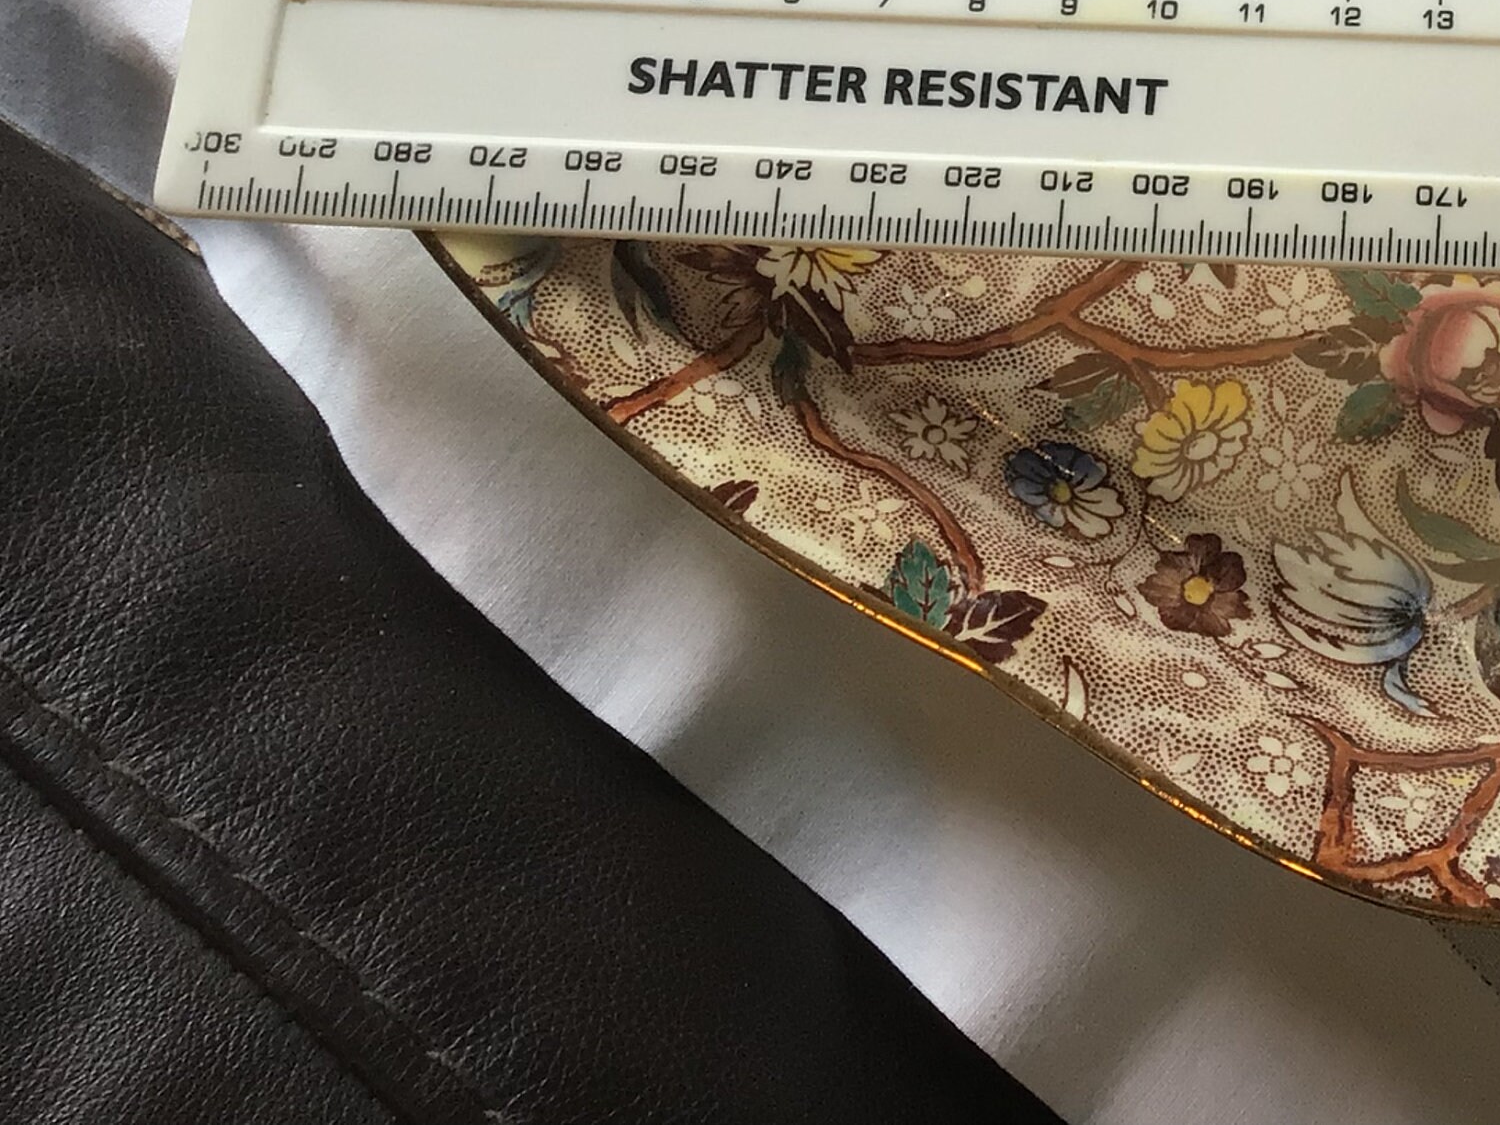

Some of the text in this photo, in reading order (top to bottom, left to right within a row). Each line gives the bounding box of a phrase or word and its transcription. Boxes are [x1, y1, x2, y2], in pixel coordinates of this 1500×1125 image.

[1147, 0, 1178, 19] 10
[1240, 4, 1264, 22] 11
[1331, 7, 1361, 26] 12
[1423, 10, 1453, 29] 13
[628, 57, 1168, 115] SHATTER RESISTANT
[375, 142, 432, 163] 280
[470, 146, 527, 168] 270
[565, 151, 622, 172] 260
[660, 155, 717, 176] 250
[756, 160, 812, 180] 240
[851, 163, 907, 184] 230
[945, 167, 1001, 188] 220
[1041, 171, 1093, 192] 210
[1133, 175, 1189, 196] 200
[1228, 178, 1278, 200] 190
[1322, 182, 1372, 203] 180
[1416, 186, 1467, 207] 170
